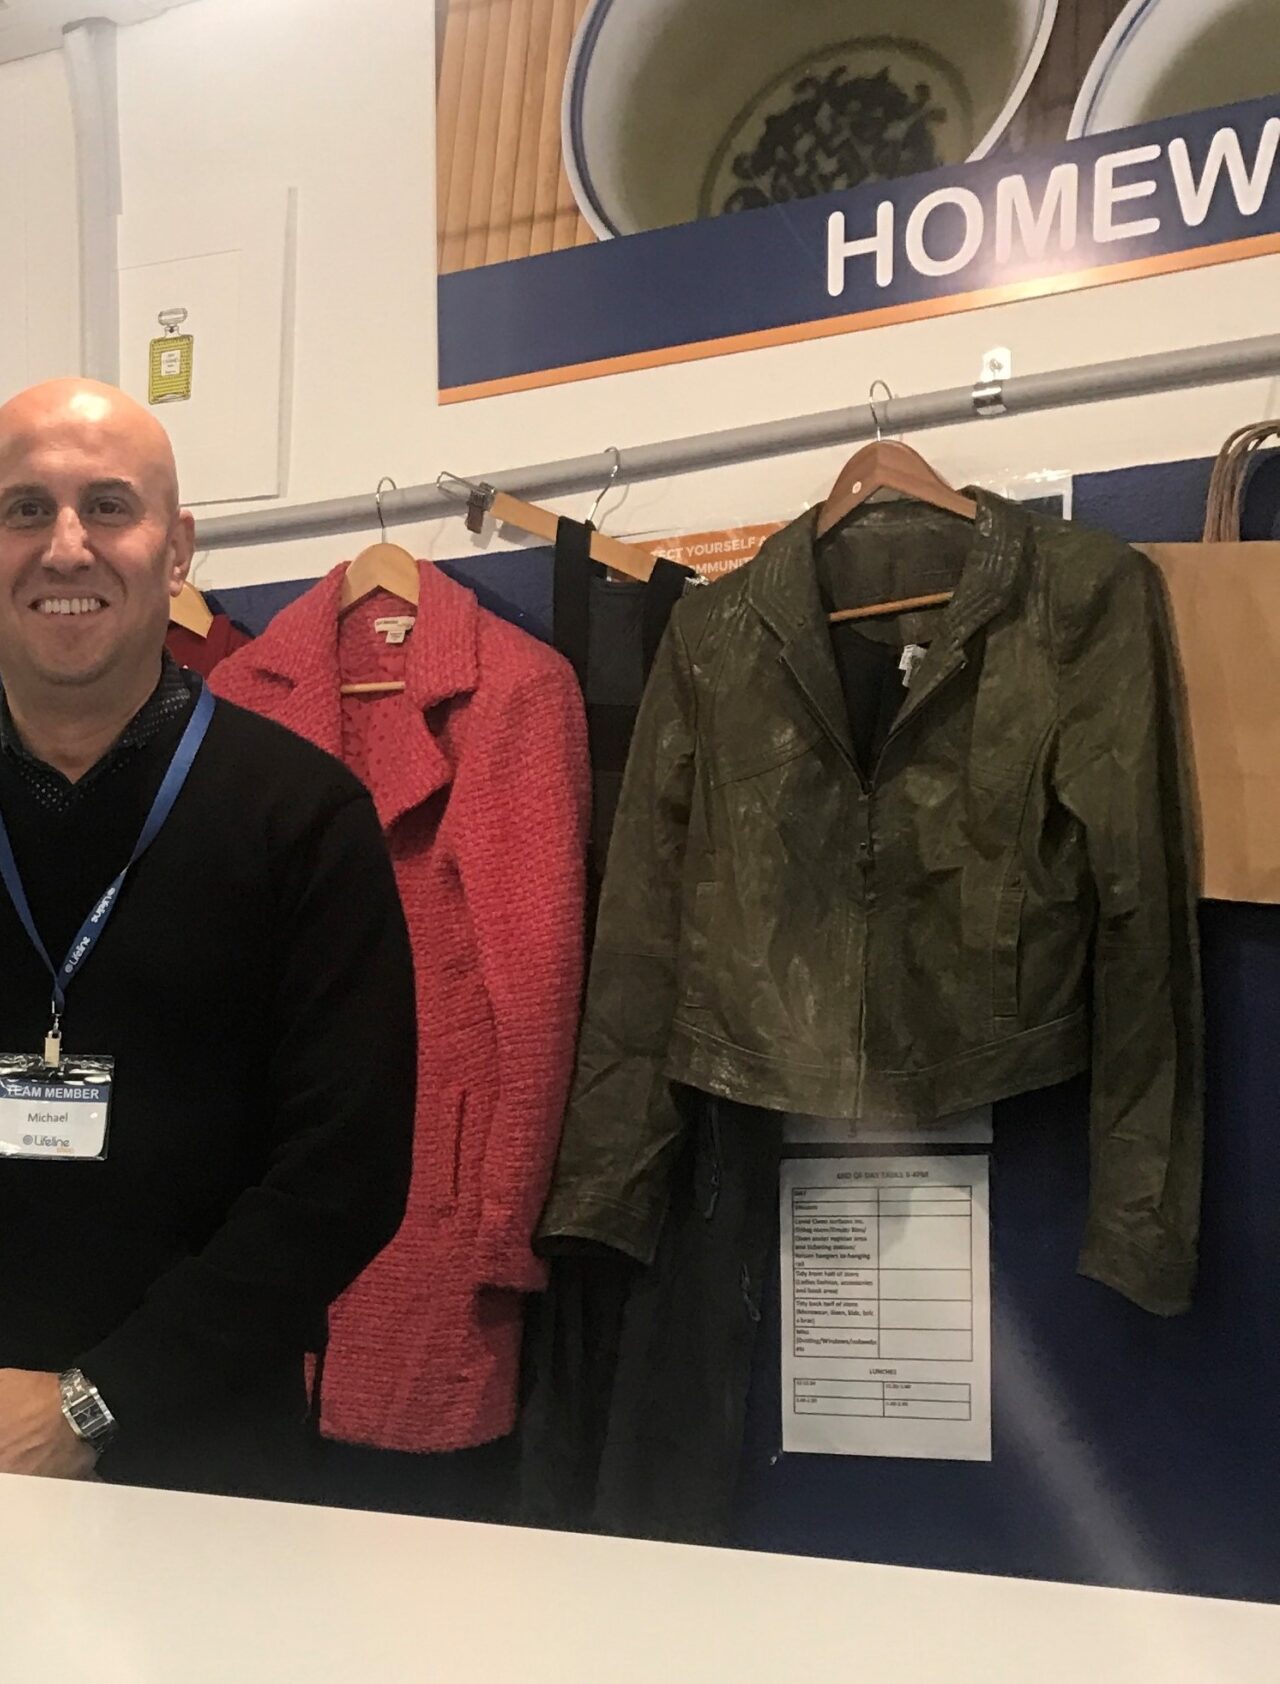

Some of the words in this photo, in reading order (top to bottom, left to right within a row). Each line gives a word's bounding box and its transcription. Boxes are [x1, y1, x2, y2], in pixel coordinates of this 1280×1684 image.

[827, 117, 1280, 296] HOMEW
[686, 536, 756, 557] YOURSELF
[6, 1085, 41, 1097] TEAM
[44, 1088, 99, 1100] MEMBER
[27, 1112, 68, 1123] Michael
[34, 1135, 70, 1147] Lifeline
